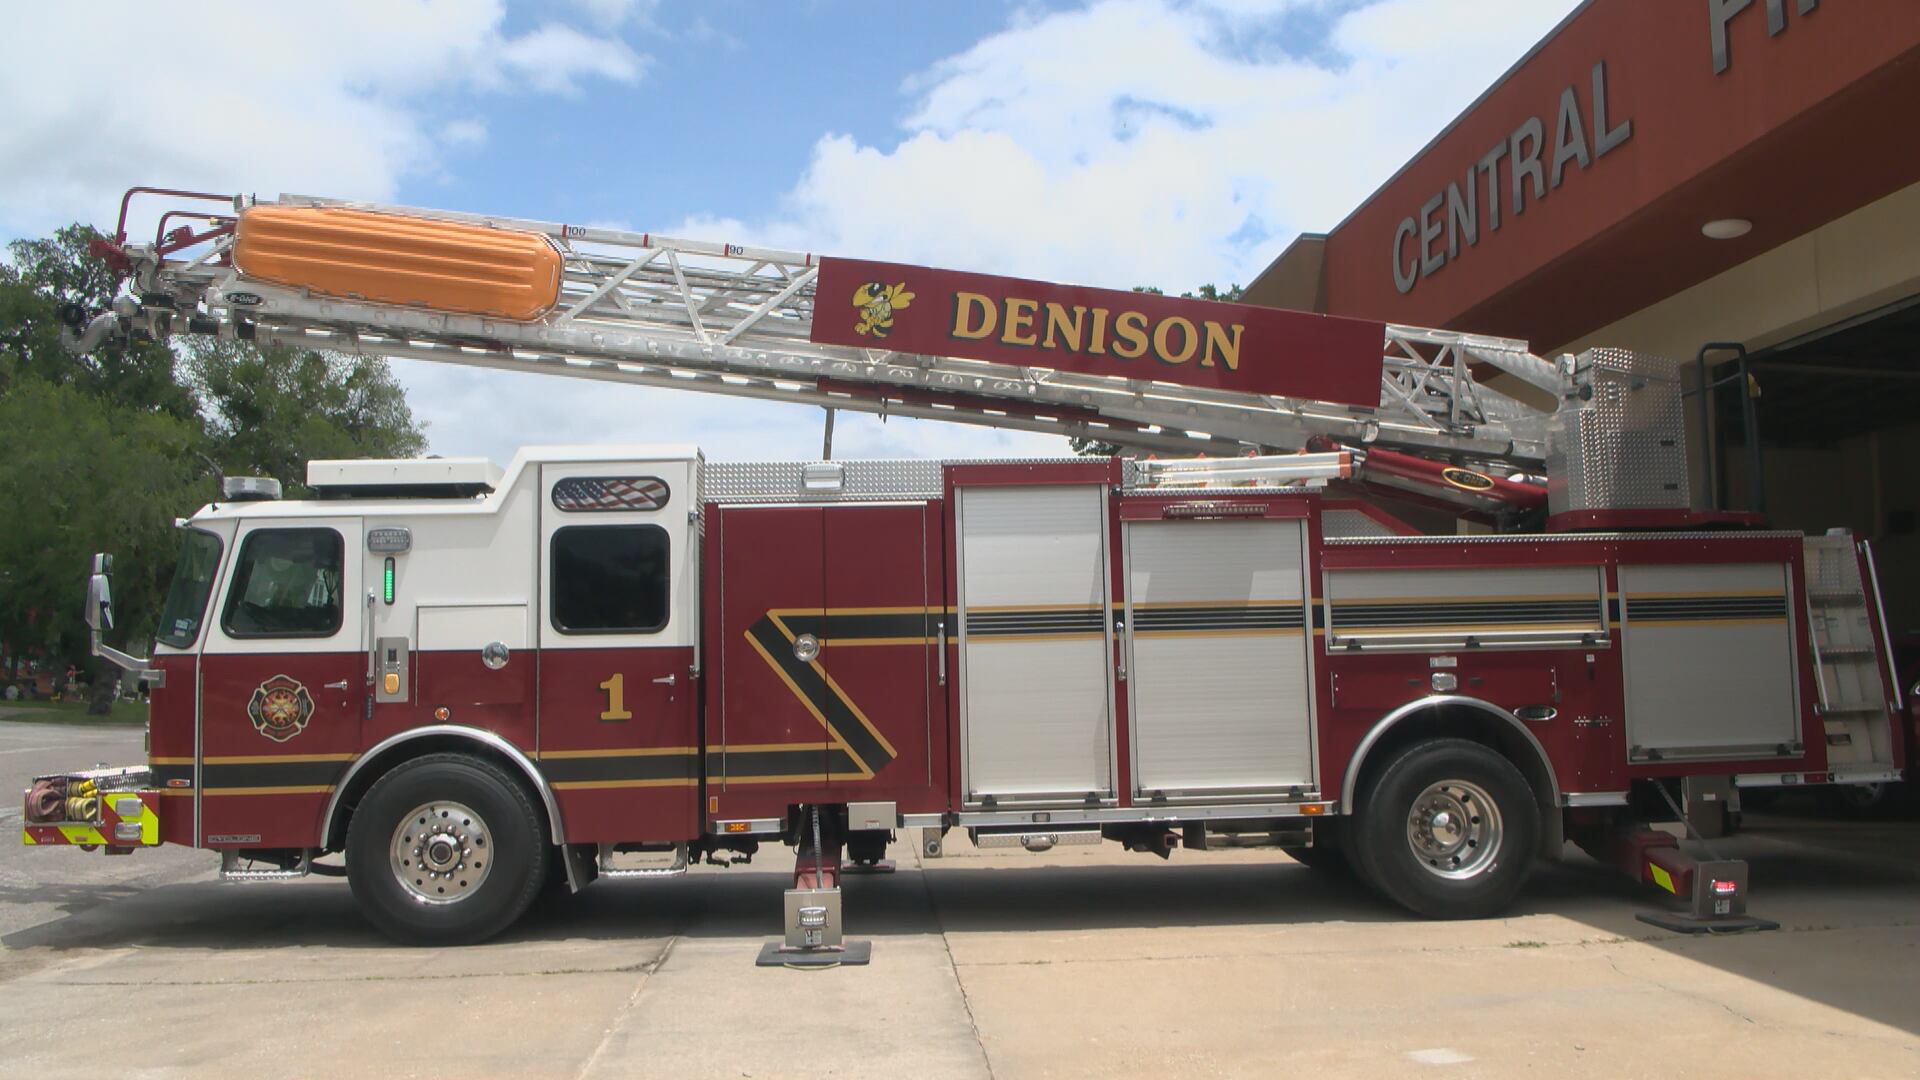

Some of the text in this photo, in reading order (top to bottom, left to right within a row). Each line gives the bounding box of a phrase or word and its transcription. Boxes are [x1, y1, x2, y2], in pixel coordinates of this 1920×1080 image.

[1392, 61, 1633, 294] CENTRAL
[568, 226, 586, 237] 100
[729, 244, 744, 256] 90
[951, 292, 1246, 371] DENISON
[599, 673, 633, 720] 1
